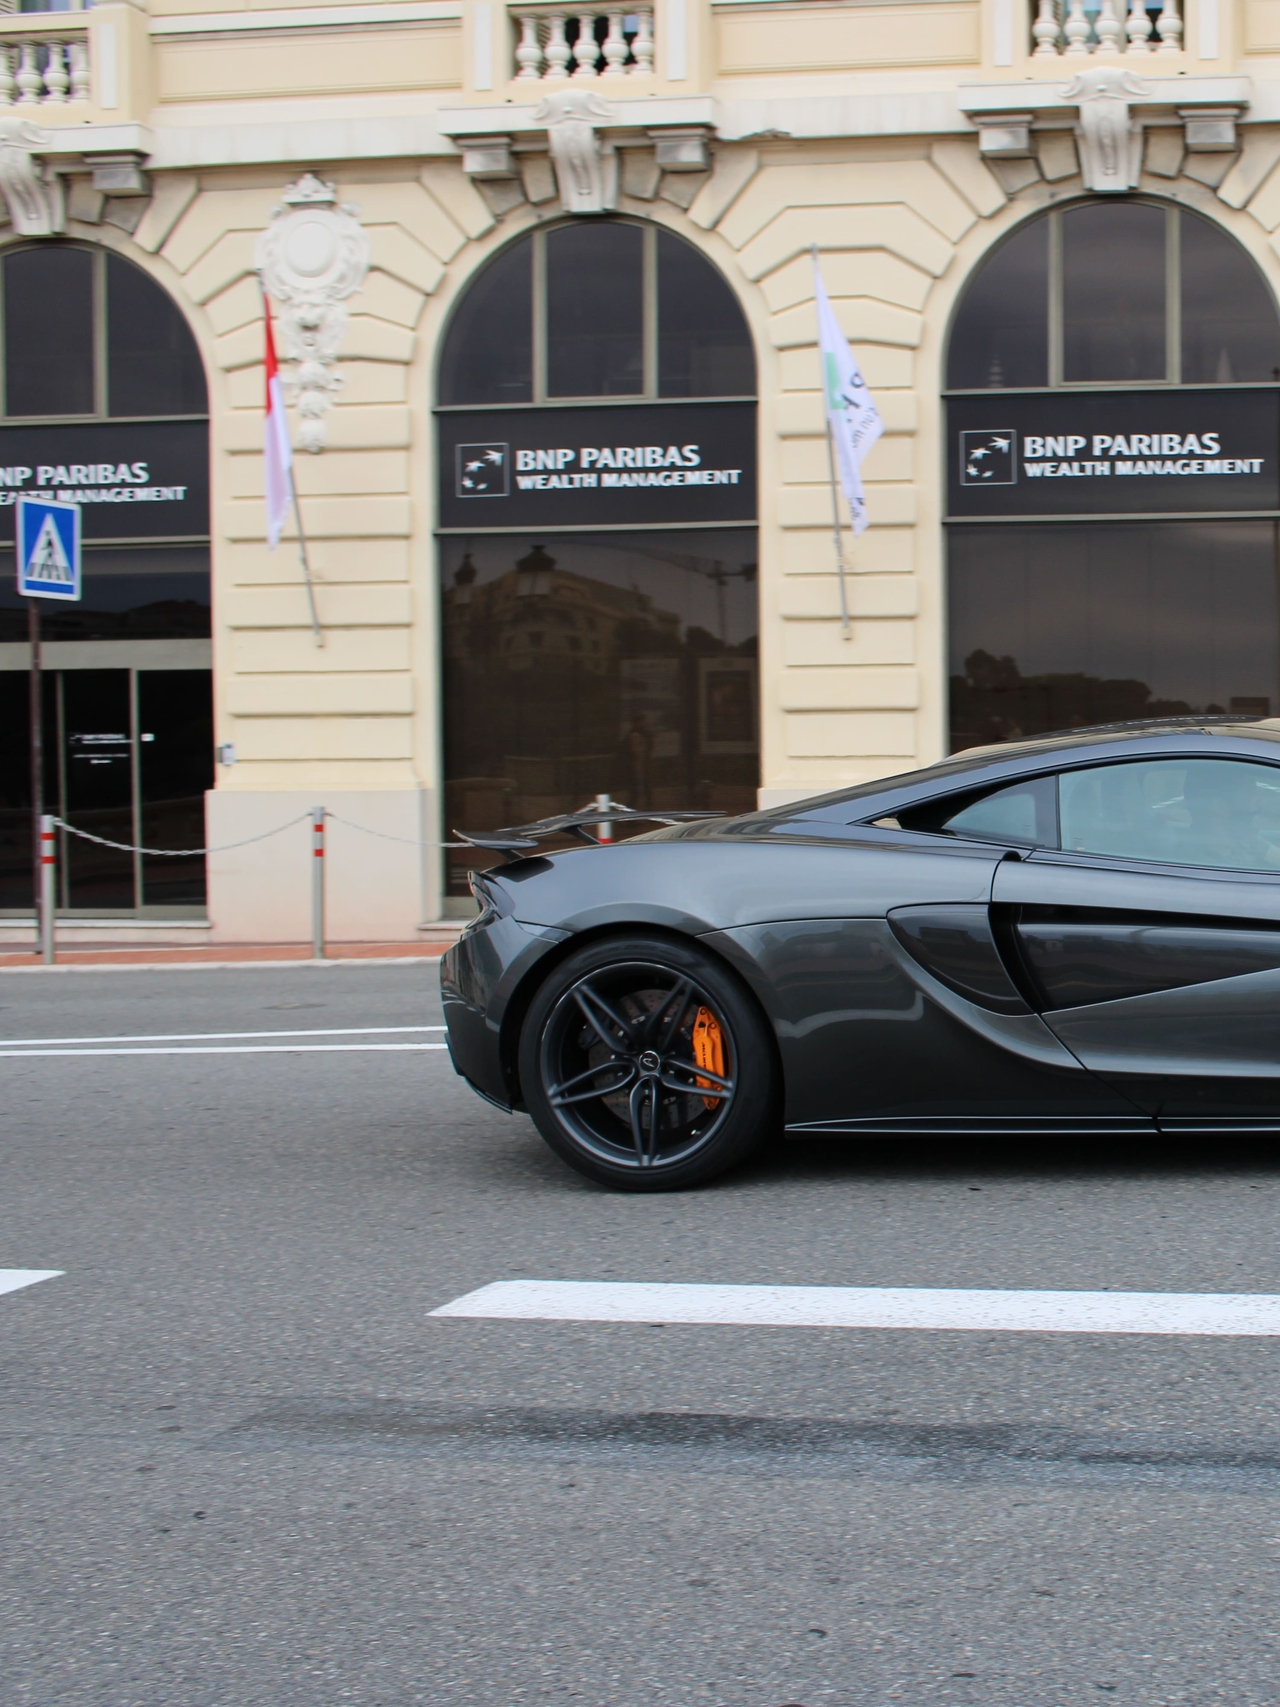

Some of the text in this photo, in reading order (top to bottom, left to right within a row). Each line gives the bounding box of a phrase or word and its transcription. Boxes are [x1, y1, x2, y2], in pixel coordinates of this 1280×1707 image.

[1023, 432, 1221, 458] BNP PARIBAS
[515, 444, 701, 471] BNP PARIBAS
[1023, 458, 1265, 477] WEALTH MANAGEMENT
[0, 461, 150, 487] NP PARIBAS
[515, 469, 743, 490] WEALTH MANAGEMENT
[56, 485, 188, 503] MANAGEMENT
